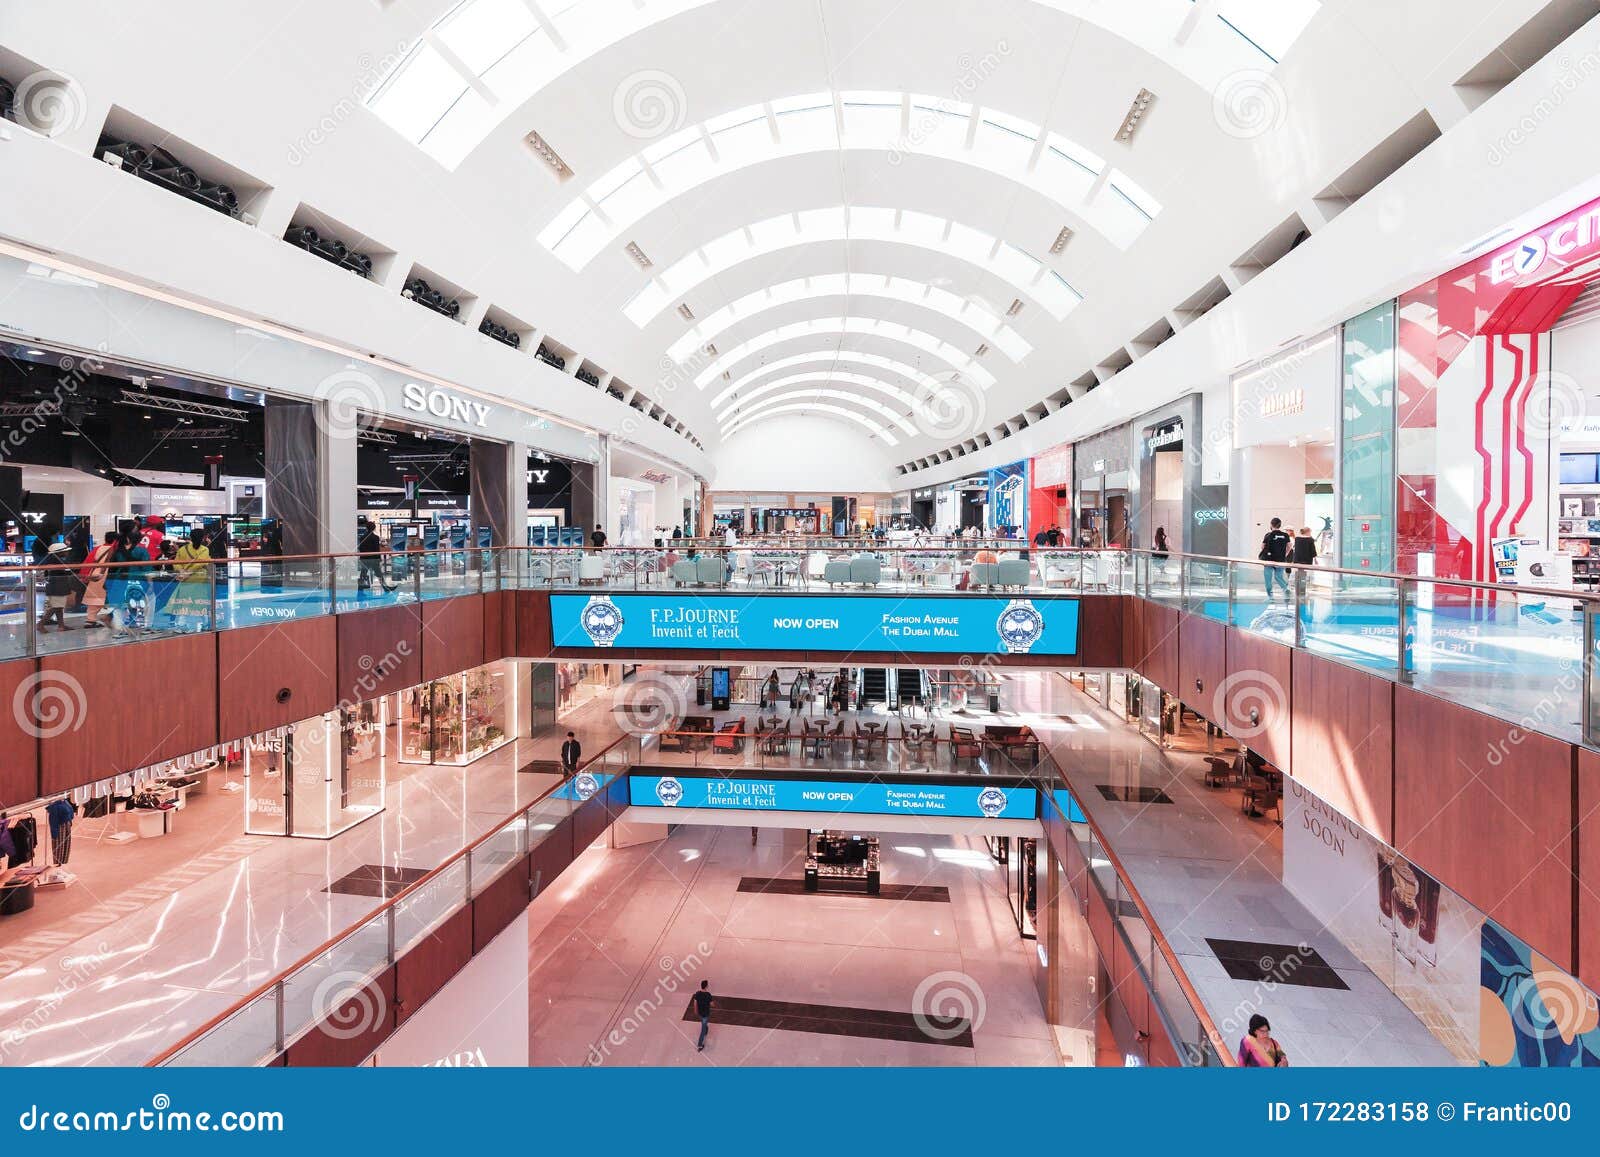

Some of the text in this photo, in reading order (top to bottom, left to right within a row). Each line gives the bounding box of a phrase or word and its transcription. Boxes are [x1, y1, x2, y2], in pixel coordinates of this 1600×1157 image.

[402, 383, 491, 427] SONY
[651, 608, 739, 624] F.P.JOURNE
[883, 614, 959, 624] FASHION AVENUE
[774, 619, 839, 629] NOW OPEN
[652, 624, 739, 639] Invenit et Fecit
[882, 627, 959, 637] THE DUBAI MALL
[707, 782, 776, 796] F.P.JOURNE
[708, 794, 776, 806] Invenit et Fecit
[802, 792, 853, 801] NOW OPEN
[1304, 809, 1345, 856] SOON
